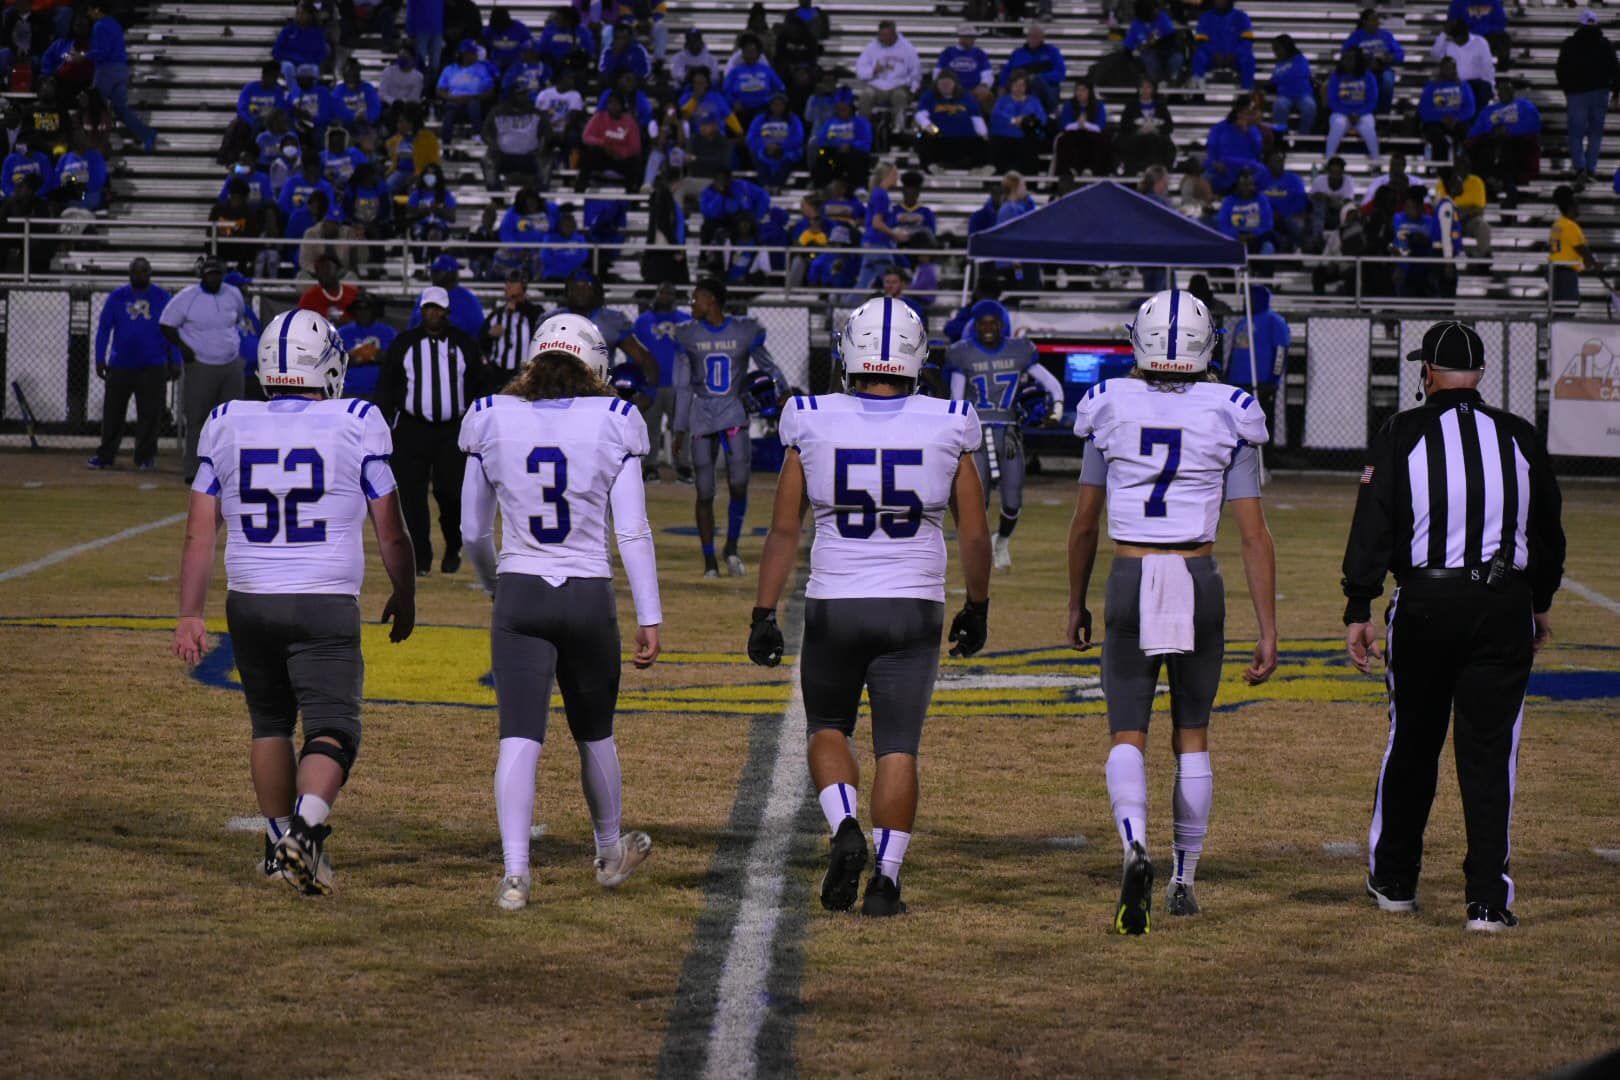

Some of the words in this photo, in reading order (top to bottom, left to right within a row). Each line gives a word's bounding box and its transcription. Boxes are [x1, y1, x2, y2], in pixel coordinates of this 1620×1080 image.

[540, 341, 581, 354] Riddell
[863, 362, 905, 373] Riddell
[1151, 361, 1193, 371] Riddell
[266, 375, 304, 385] Riddell
[704, 353, 732, 394] 0
[970, 371, 1019, 411] 17
[1140, 427, 1182, 518] 7
[239, 448, 327, 544] 52
[526, 446, 571, 544] 3
[834, 447, 924, 539] 55
